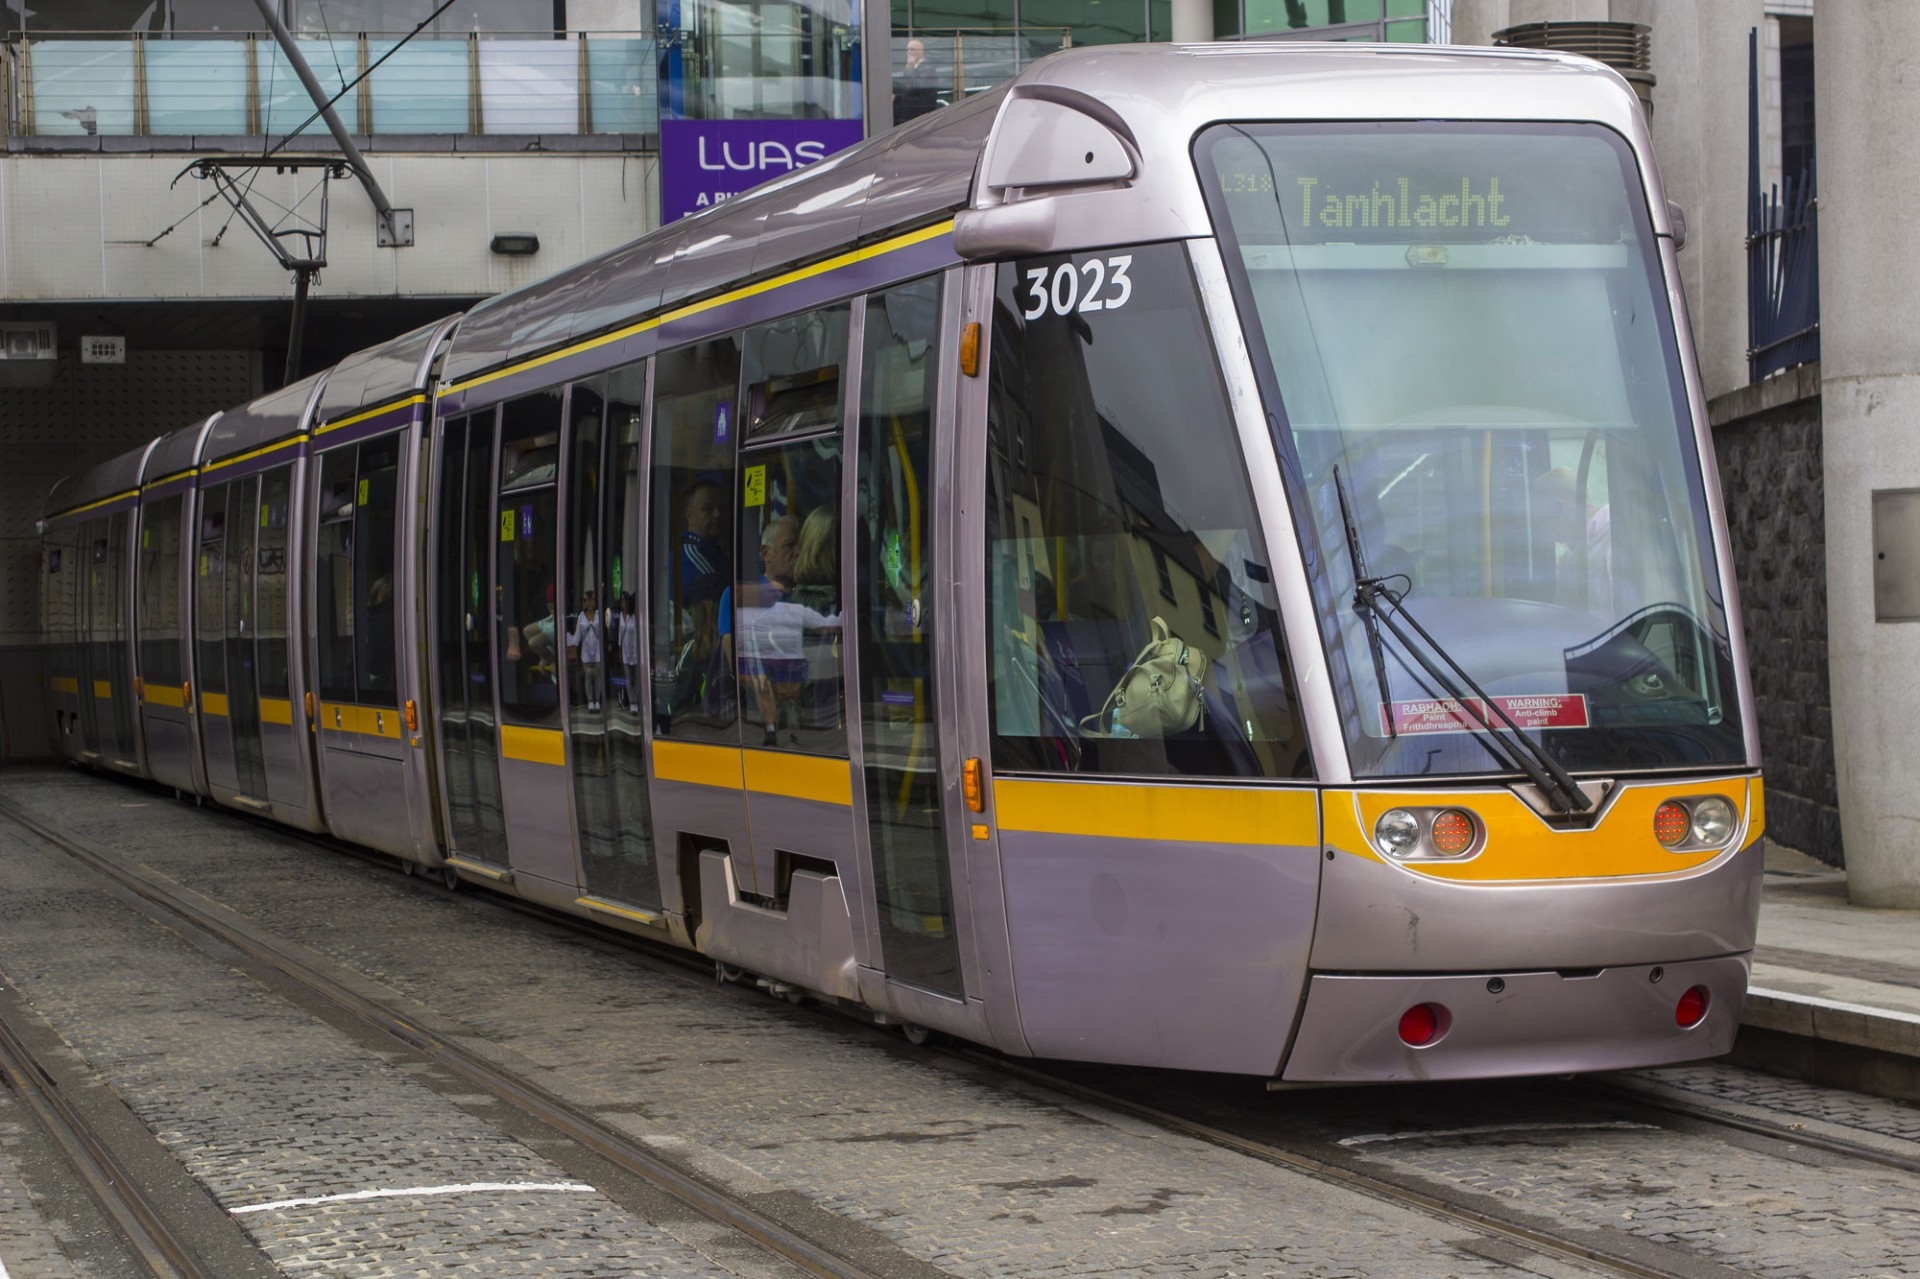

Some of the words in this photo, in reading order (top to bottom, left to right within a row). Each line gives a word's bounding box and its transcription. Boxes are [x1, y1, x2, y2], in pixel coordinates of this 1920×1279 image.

[698, 135, 826, 171] LUAS
[696, 192, 710, 206] A
[1297, 177, 1511, 227] Tamhlacht
[1025, 254, 1133, 321] 3023
[1507, 698, 1562, 709] WARNING:
[1515, 709, 1558, 718] Anti-climb
[1527, 718, 1549, 727] paint
